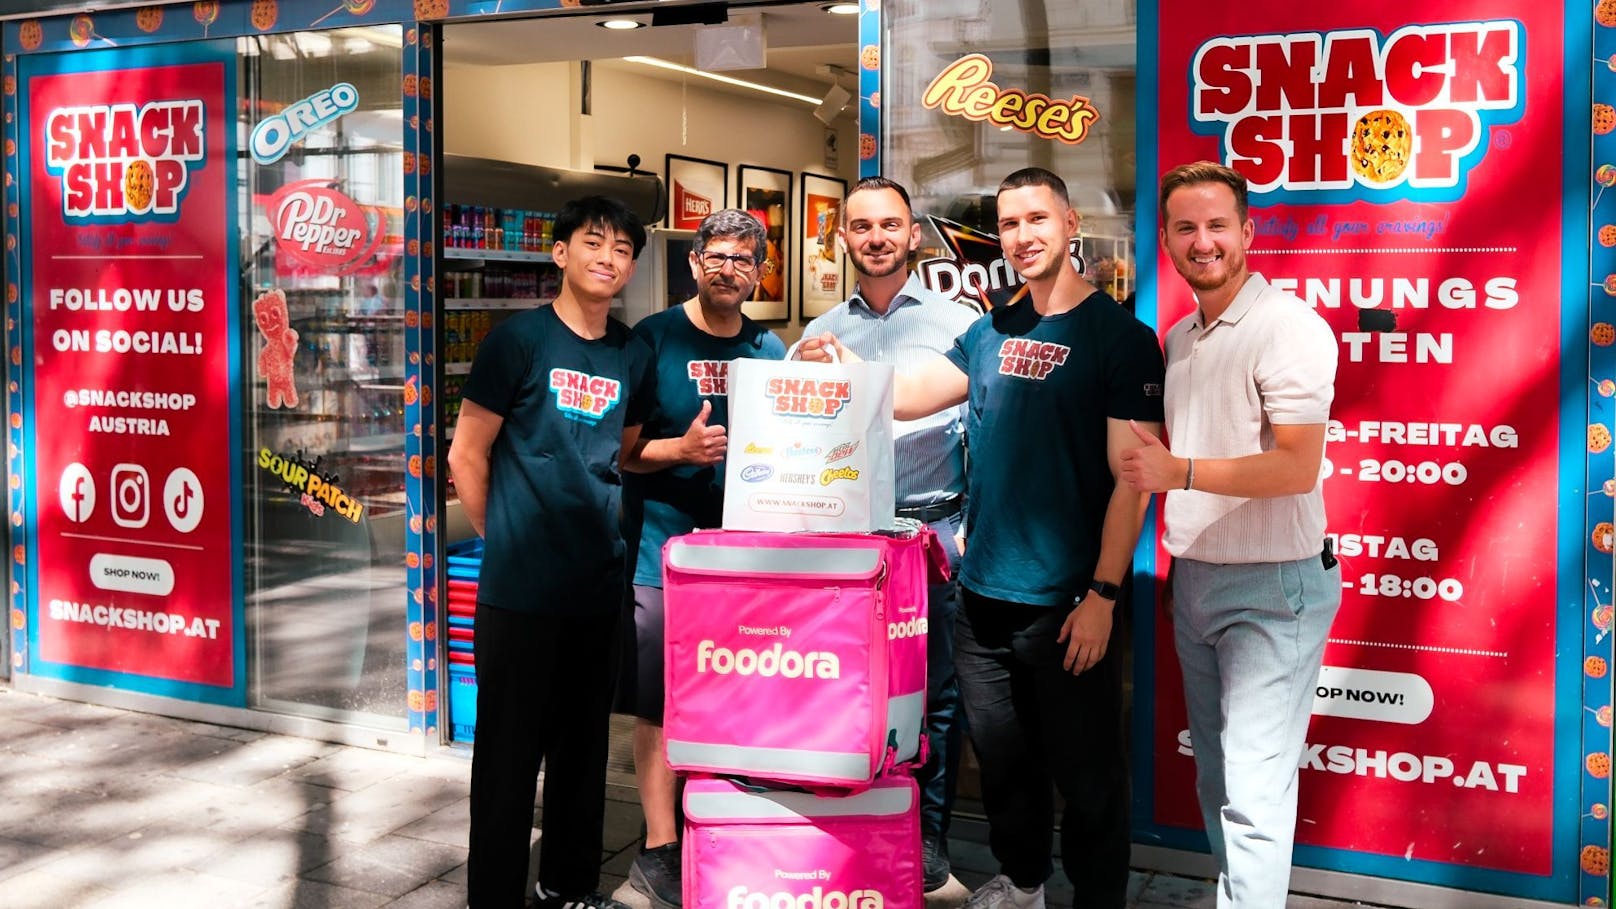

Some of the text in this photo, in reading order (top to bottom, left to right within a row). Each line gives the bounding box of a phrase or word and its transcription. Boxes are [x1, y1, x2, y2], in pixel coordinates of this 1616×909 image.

[1198, 28, 1511, 115] SNACK
[924, 55, 1096, 142] Reese's
[50, 104, 200, 161] SNACK
[252, 84, 358, 161] OREO
[1230, 108, 1475, 187] SHOP
[67, 158, 184, 211] SHOP
[277, 191, 361, 253] Pepper
[310, 195, 346, 226] Dr
[1306, 214, 1328, 234] all
[1333, 221, 1369, 241] your
[50, 288, 205, 312] FOLLOW US
[52, 328, 203, 355] ON SOCIAL!
[1001, 340, 1069, 364] SNACK
[1342, 332, 1453, 364] TEN
[689, 362, 728, 379] SNA
[1001, 357, 1053, 379] SHOP
[551, 370, 620, 399] SNACK
[699, 378, 728, 394] SH
[769, 378, 849, 398] SNACK
[63, 388, 197, 411] @SNACKSHOP
[560, 388, 608, 413] SHOP
[775, 395, 841, 415] SHOP
[88, 415, 171, 437] AUSTRIA
[1326, 419, 1519, 448] G-FREITAG
[820, 466, 859, 486] Cheetos
[1358, 459, 1468, 485] 20:00
[258, 448, 364, 524] SOUR PATCH
[104, 567, 160, 582] SHOP NOW!
[1360, 573, 1464, 601] 18:00
[49, 599, 221, 640] SNACKSHOP.AT
[738, 625, 792, 638] Powered By
[697, 639, 840, 680] foodora
[1315, 686, 1405, 706] OP NOW!
[775, 869, 831, 881] Powered By
[727, 885, 884, 909] foodora
